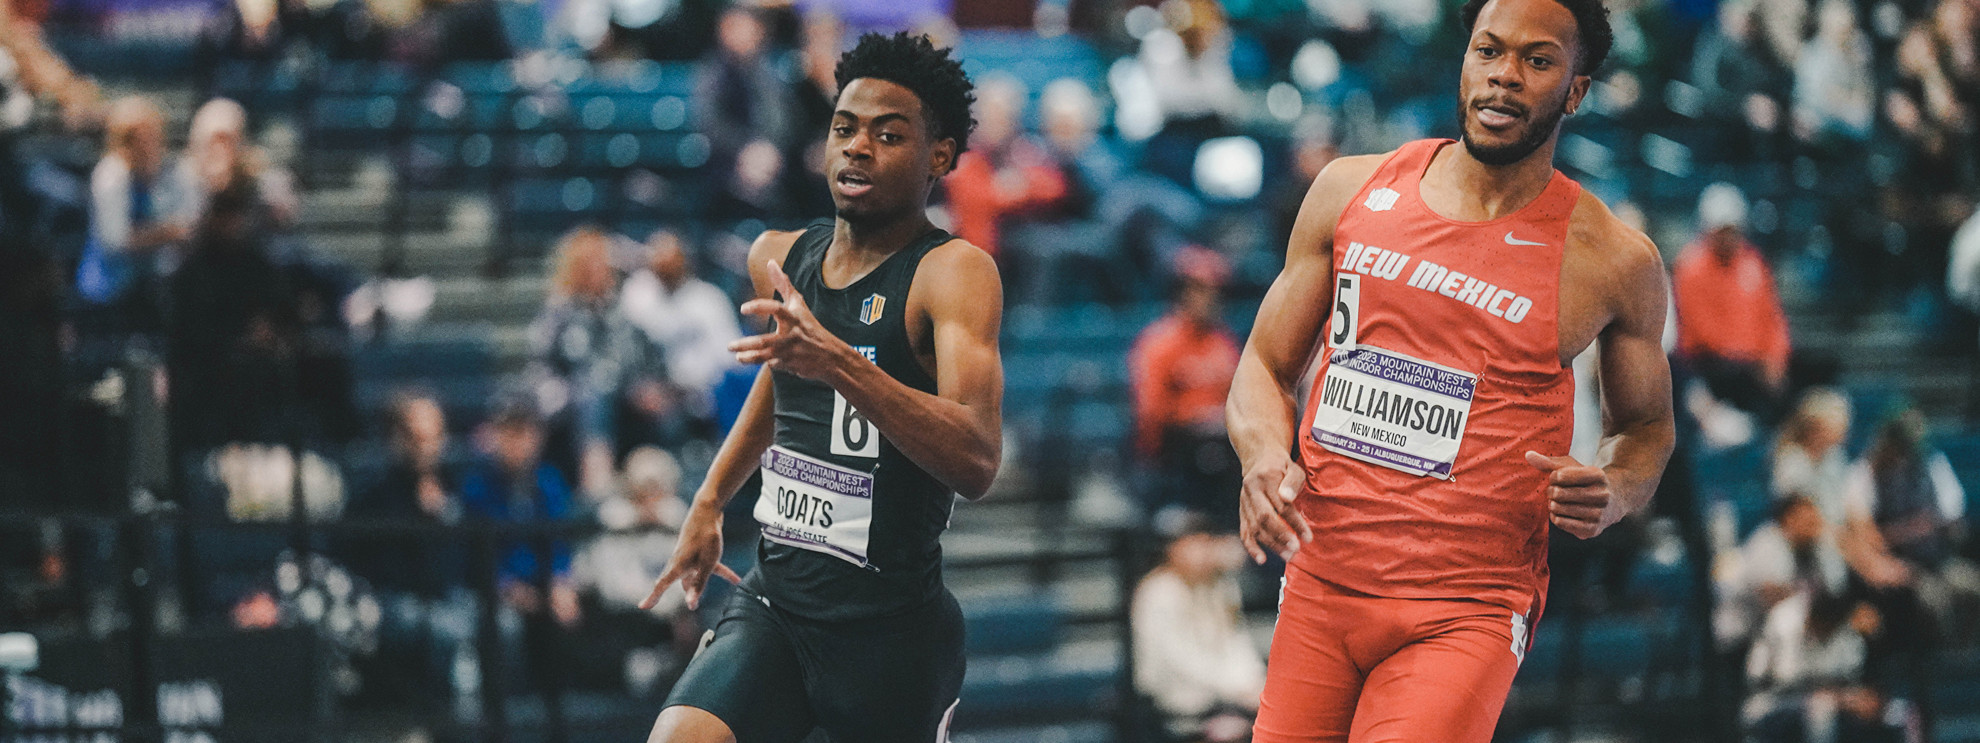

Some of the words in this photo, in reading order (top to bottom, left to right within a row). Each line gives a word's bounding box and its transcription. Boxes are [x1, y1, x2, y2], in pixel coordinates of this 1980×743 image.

[1334, 277, 1352, 345] 5
[1407, 260, 1533, 324] MEXICO
[1349, 358, 1381, 376] INDOOR
[1383, 368, 1470, 399] CHAMPIONSHIPS
[1357, 351, 1377, 363] 2023
[1380, 356, 1435, 379] MOUNTAIN
[1437, 370, 1467, 387] WEST
[842, 401, 869, 452] 6
[1323, 375, 1463, 440] WILLIAMSON
[1350, 421, 1370, 438] NEW
[1371, 427, 1407, 448] MEXICO
[777, 454, 796, 468] 2023
[796, 460, 837, 481] MOUNTAIN
[838, 472, 865, 487] WEST
[1348, 441, 1357, 450] 23
[1423, 461, 1436, 471] NM
[773, 462, 799, 479] INDOOR
[800, 470, 870, 497] CHAMPIONSHIPS
[777, 486, 833, 528] COATS
[803, 531, 828, 543] STATE
